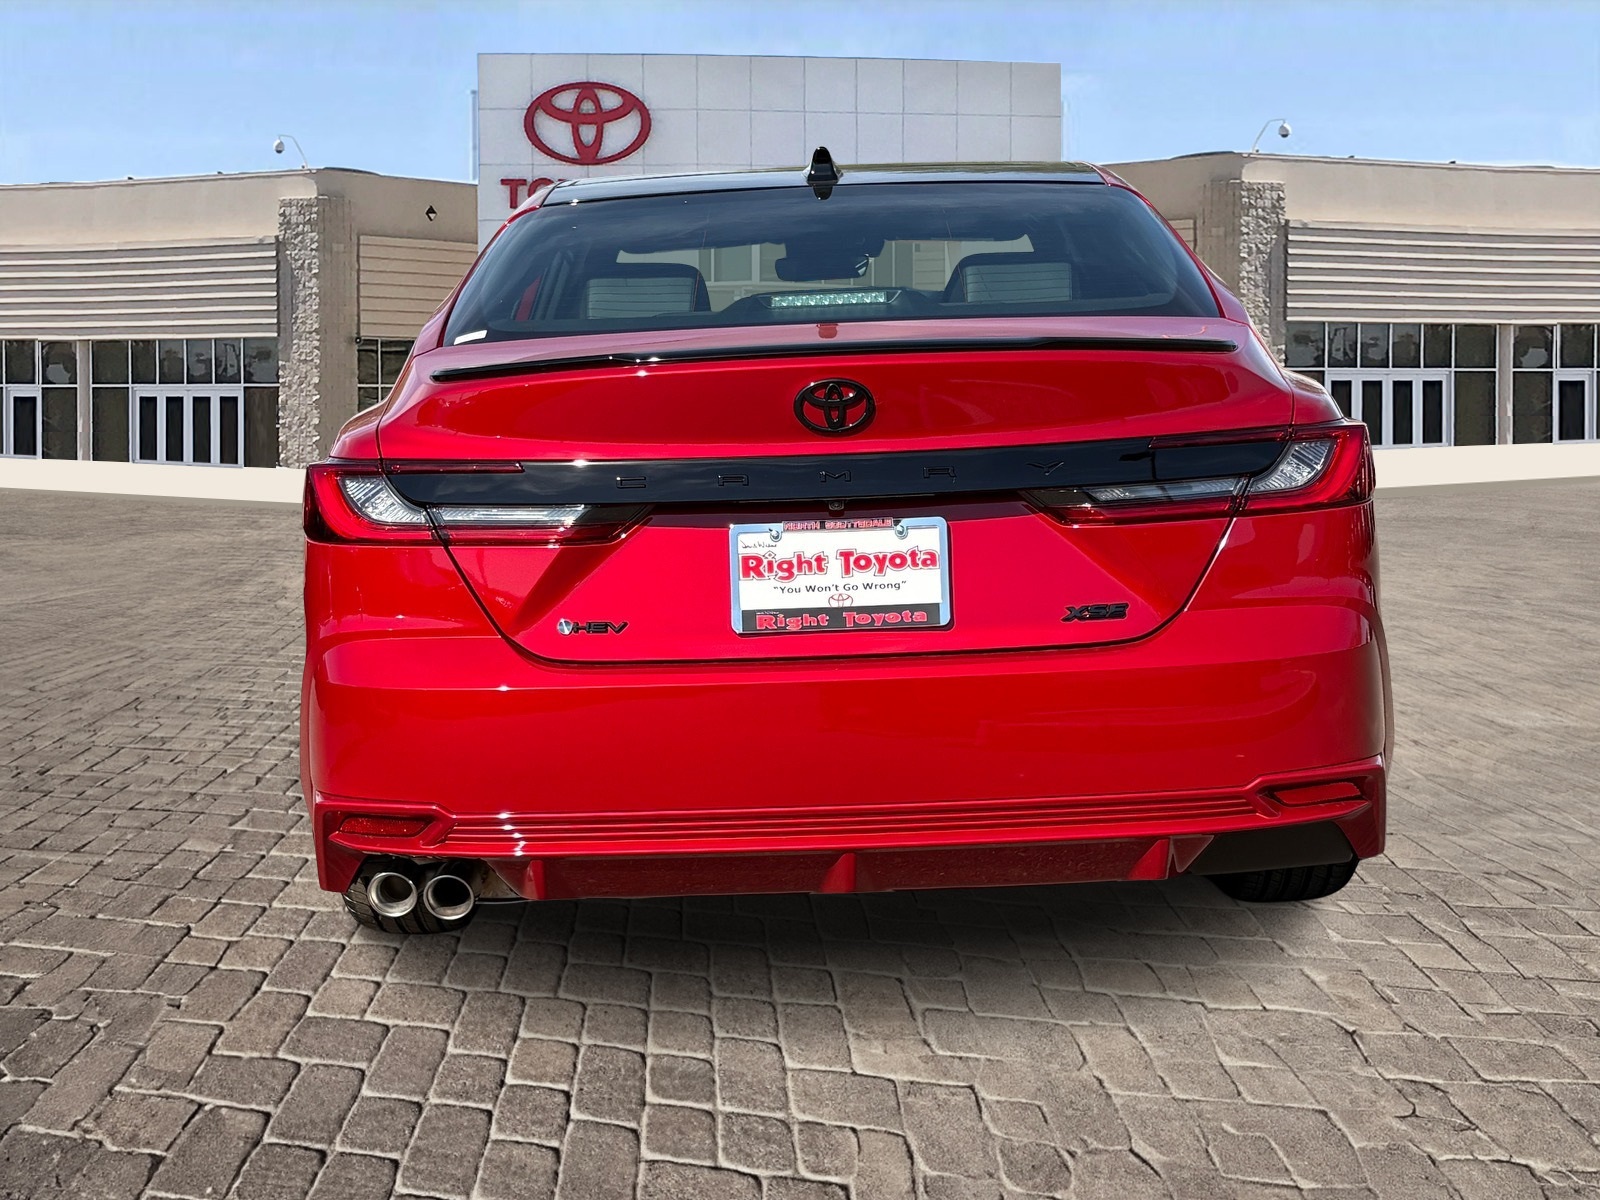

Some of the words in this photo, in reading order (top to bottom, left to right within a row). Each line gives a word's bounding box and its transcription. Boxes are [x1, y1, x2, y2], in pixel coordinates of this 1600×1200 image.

[616, 460, 1064, 489] CAMRY
[740, 550, 829, 583] Right
[837, 546, 940, 578] Toyota
[773, 585, 801, 594] "You
[805, 584, 840, 593] Won't
[843, 583, 859, 591] Go
[862, 580, 907, 590] Wrong"
[756, 613, 829, 630] Right
[843, 610, 928, 627] Toyota
[1060, 602, 1129, 622] XSE
[572, 621, 629, 634] HEV
